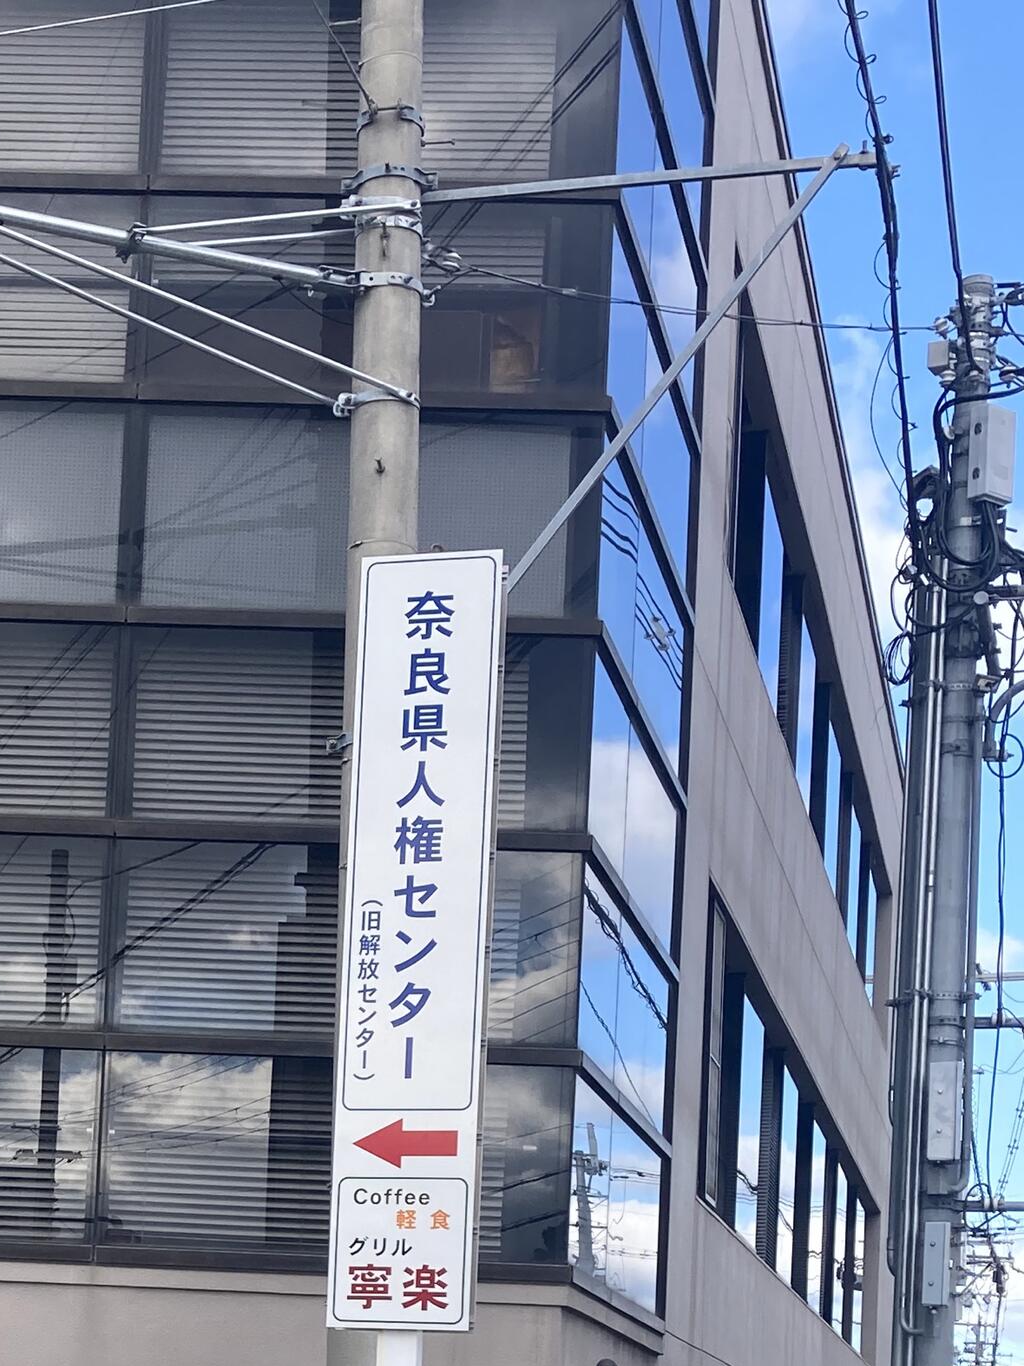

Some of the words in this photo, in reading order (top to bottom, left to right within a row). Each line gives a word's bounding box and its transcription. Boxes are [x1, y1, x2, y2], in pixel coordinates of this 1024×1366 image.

[388, 590, 456, 1080] 奈良県人権センター
[353, 1188, 431, 1205] Coffee
[396, 1209, 450, 1230] 軽食
[349, 1236, 413, 1256] グリル
[346, 1263, 449, 1311] 寧楽
